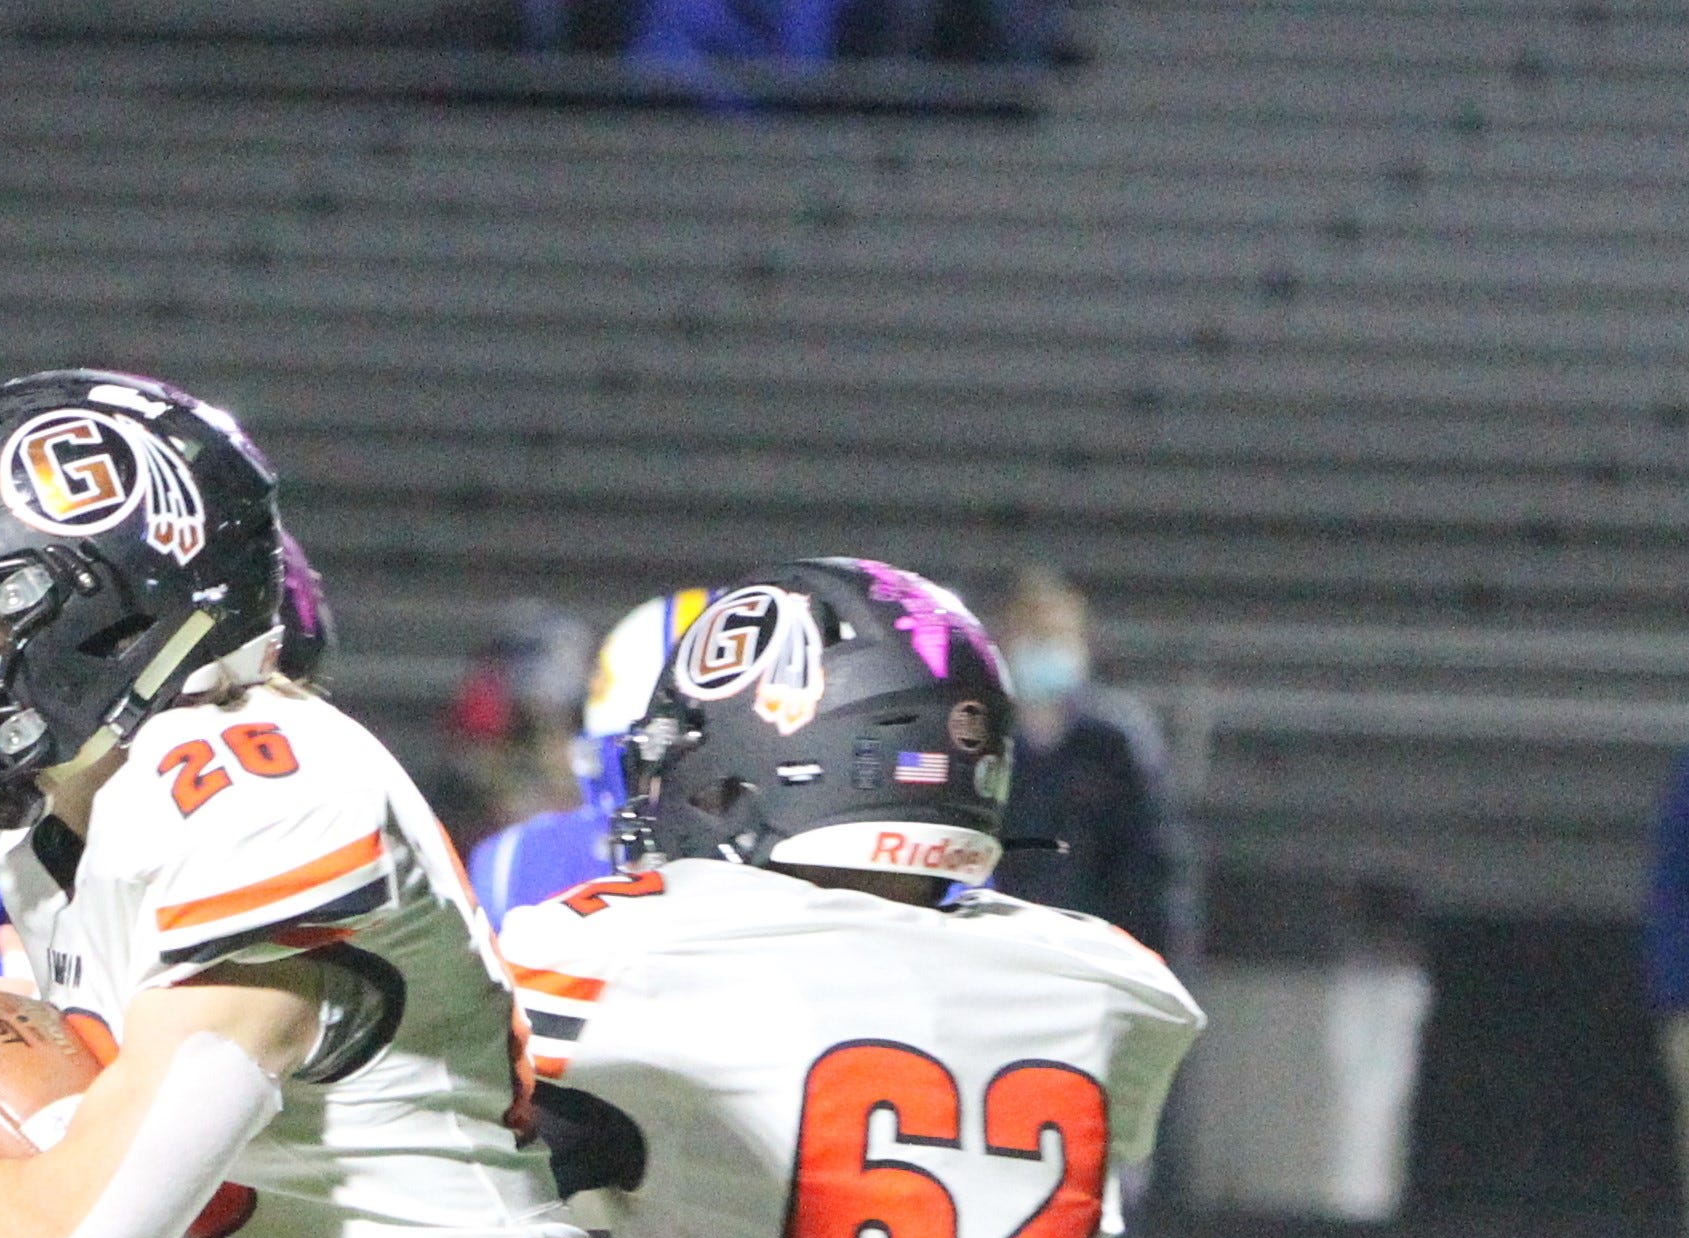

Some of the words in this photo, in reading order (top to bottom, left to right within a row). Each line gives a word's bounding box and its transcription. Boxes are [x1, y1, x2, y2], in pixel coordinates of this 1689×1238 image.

[18, 418, 125, 521] G
[688, 595, 773, 684] G
[157, 721, 300, 819] 26
